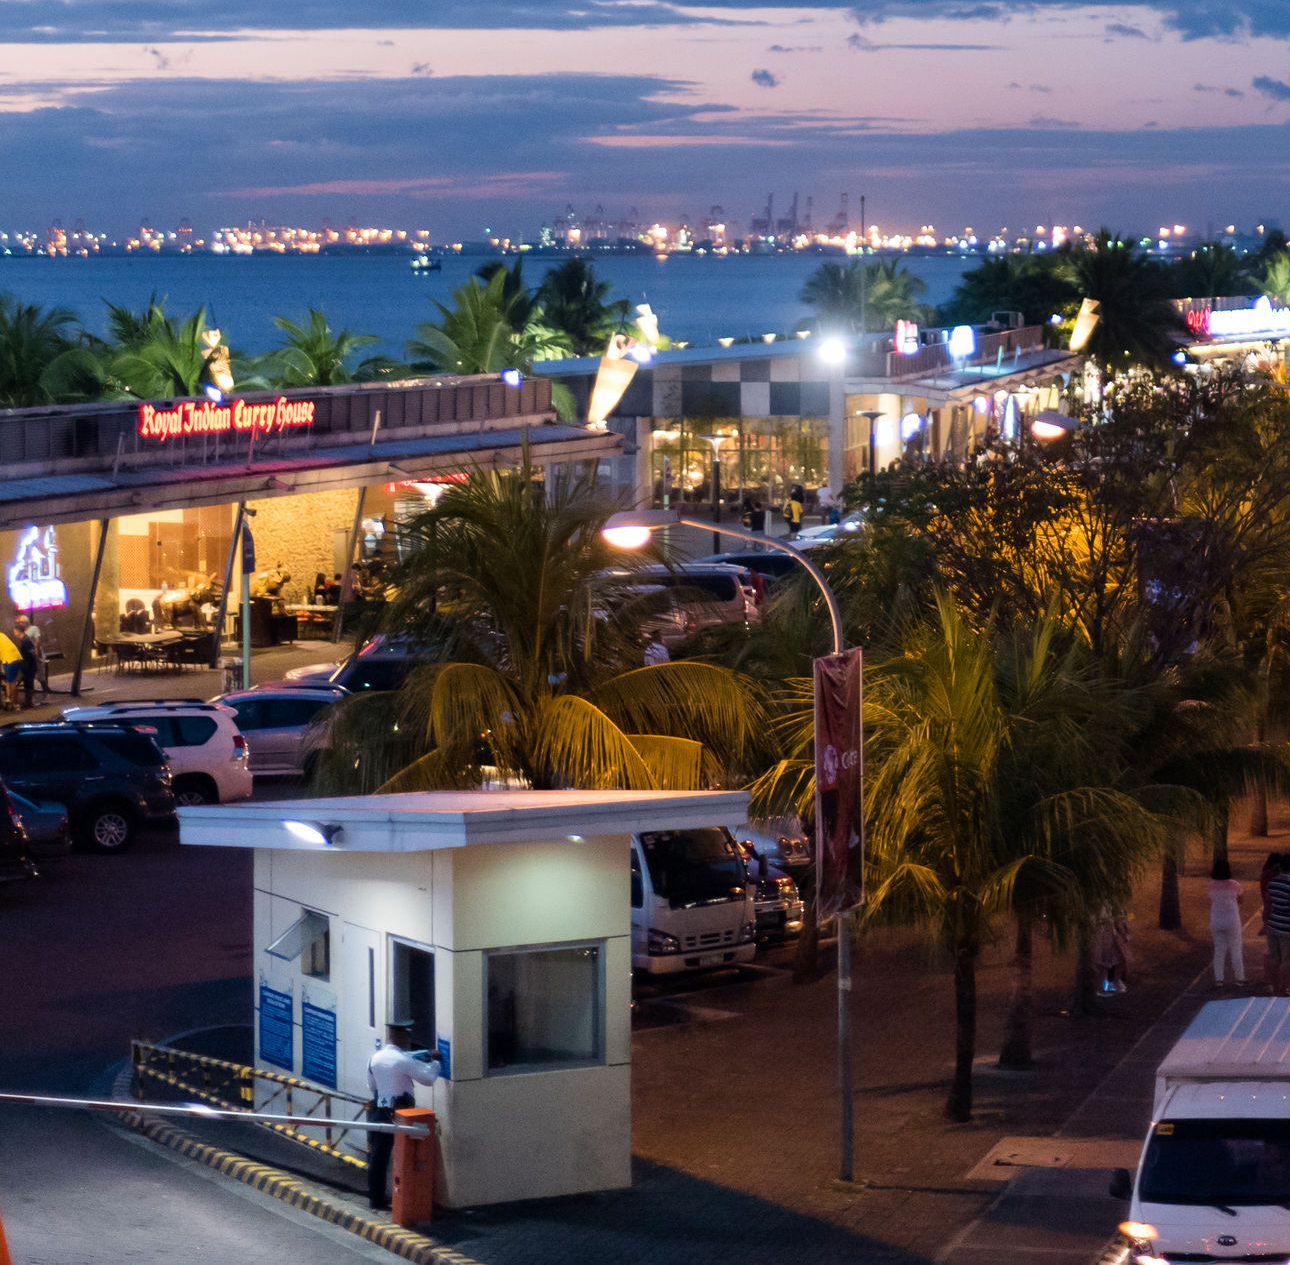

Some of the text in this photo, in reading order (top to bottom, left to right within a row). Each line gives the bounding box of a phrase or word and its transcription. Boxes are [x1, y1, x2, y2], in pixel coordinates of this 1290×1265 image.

[140, 403, 183, 442] Royal
[184, 400, 231, 433] Indian
[234, 398, 276, 433] Curry
